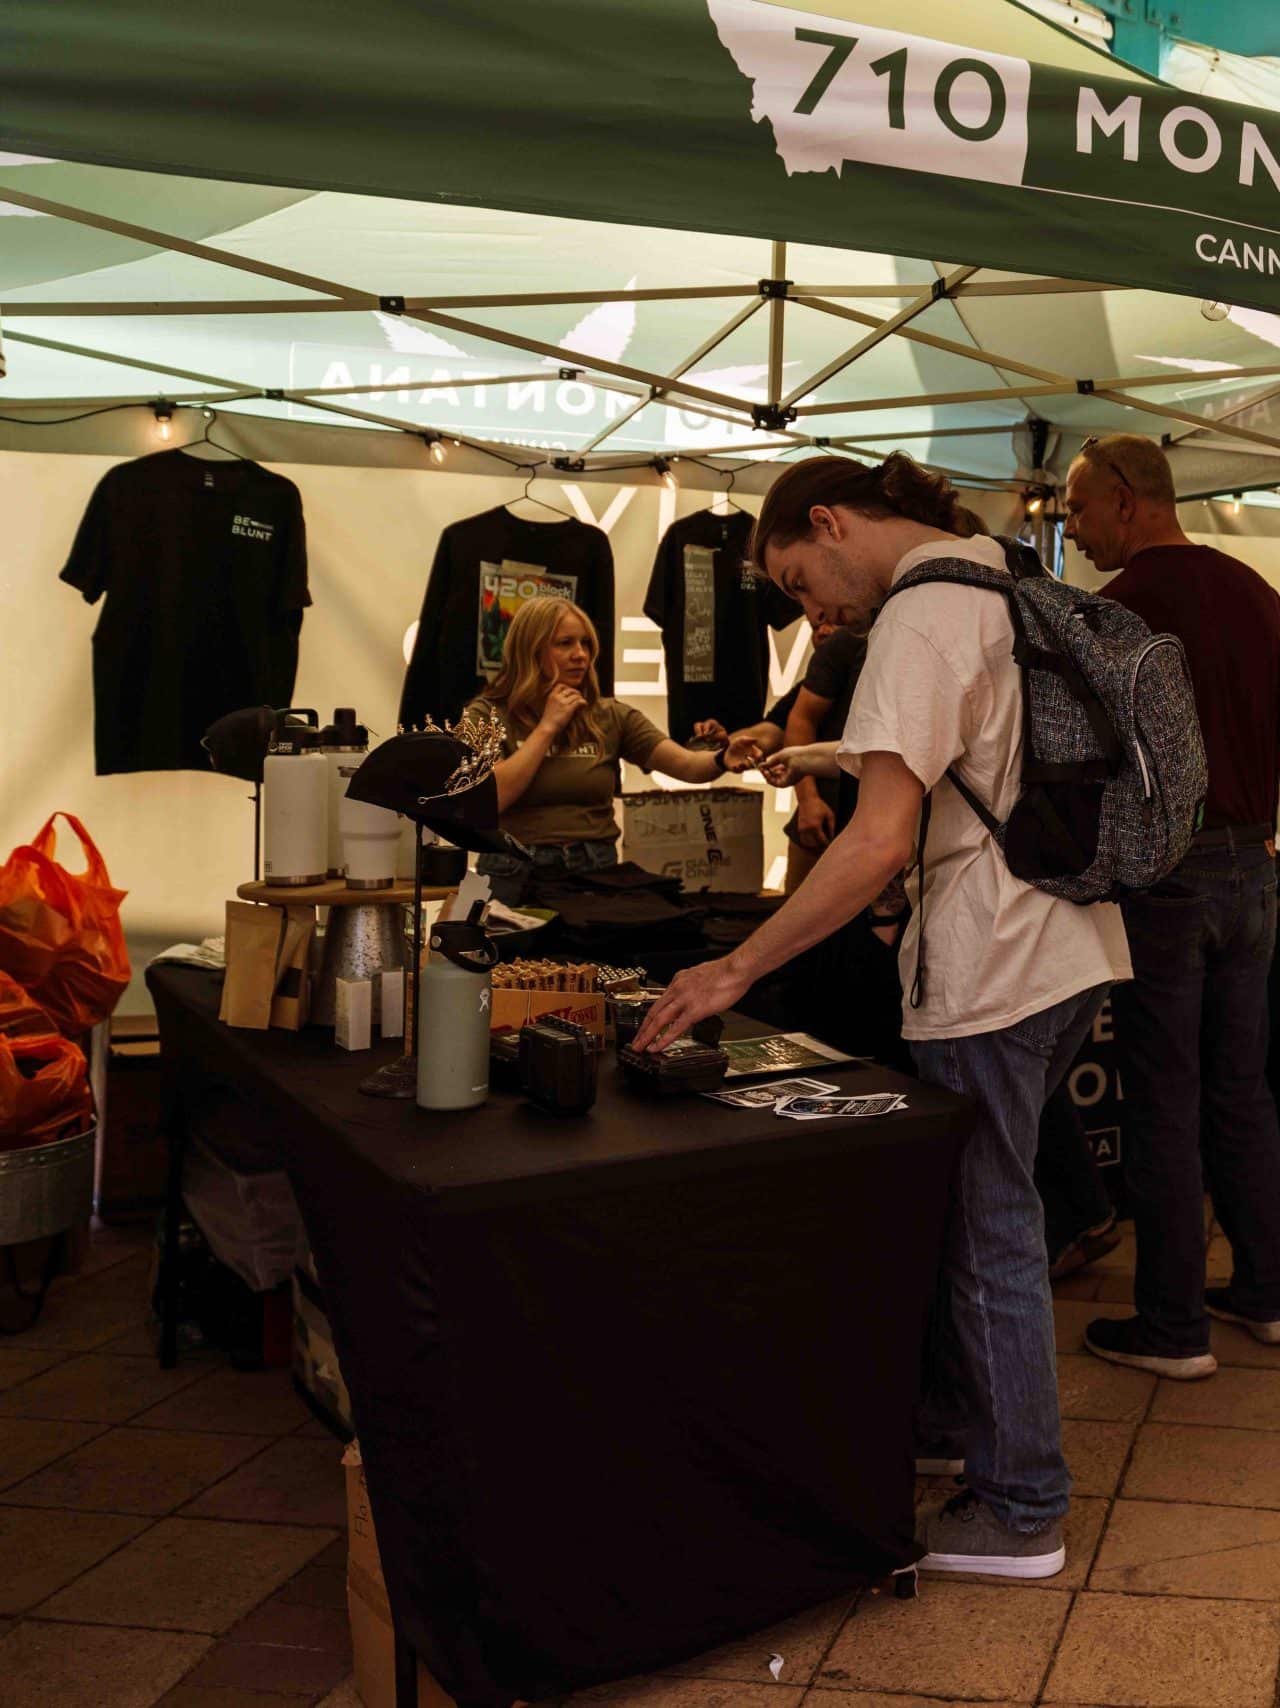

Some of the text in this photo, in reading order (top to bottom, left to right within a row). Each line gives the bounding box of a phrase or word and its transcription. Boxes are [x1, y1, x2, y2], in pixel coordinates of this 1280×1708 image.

[793, 27, 1006, 141] 710
[233, 515, 250, 526] BE
[232, 524, 272, 541] BLUNT
[485, 576, 537, 599] 420
